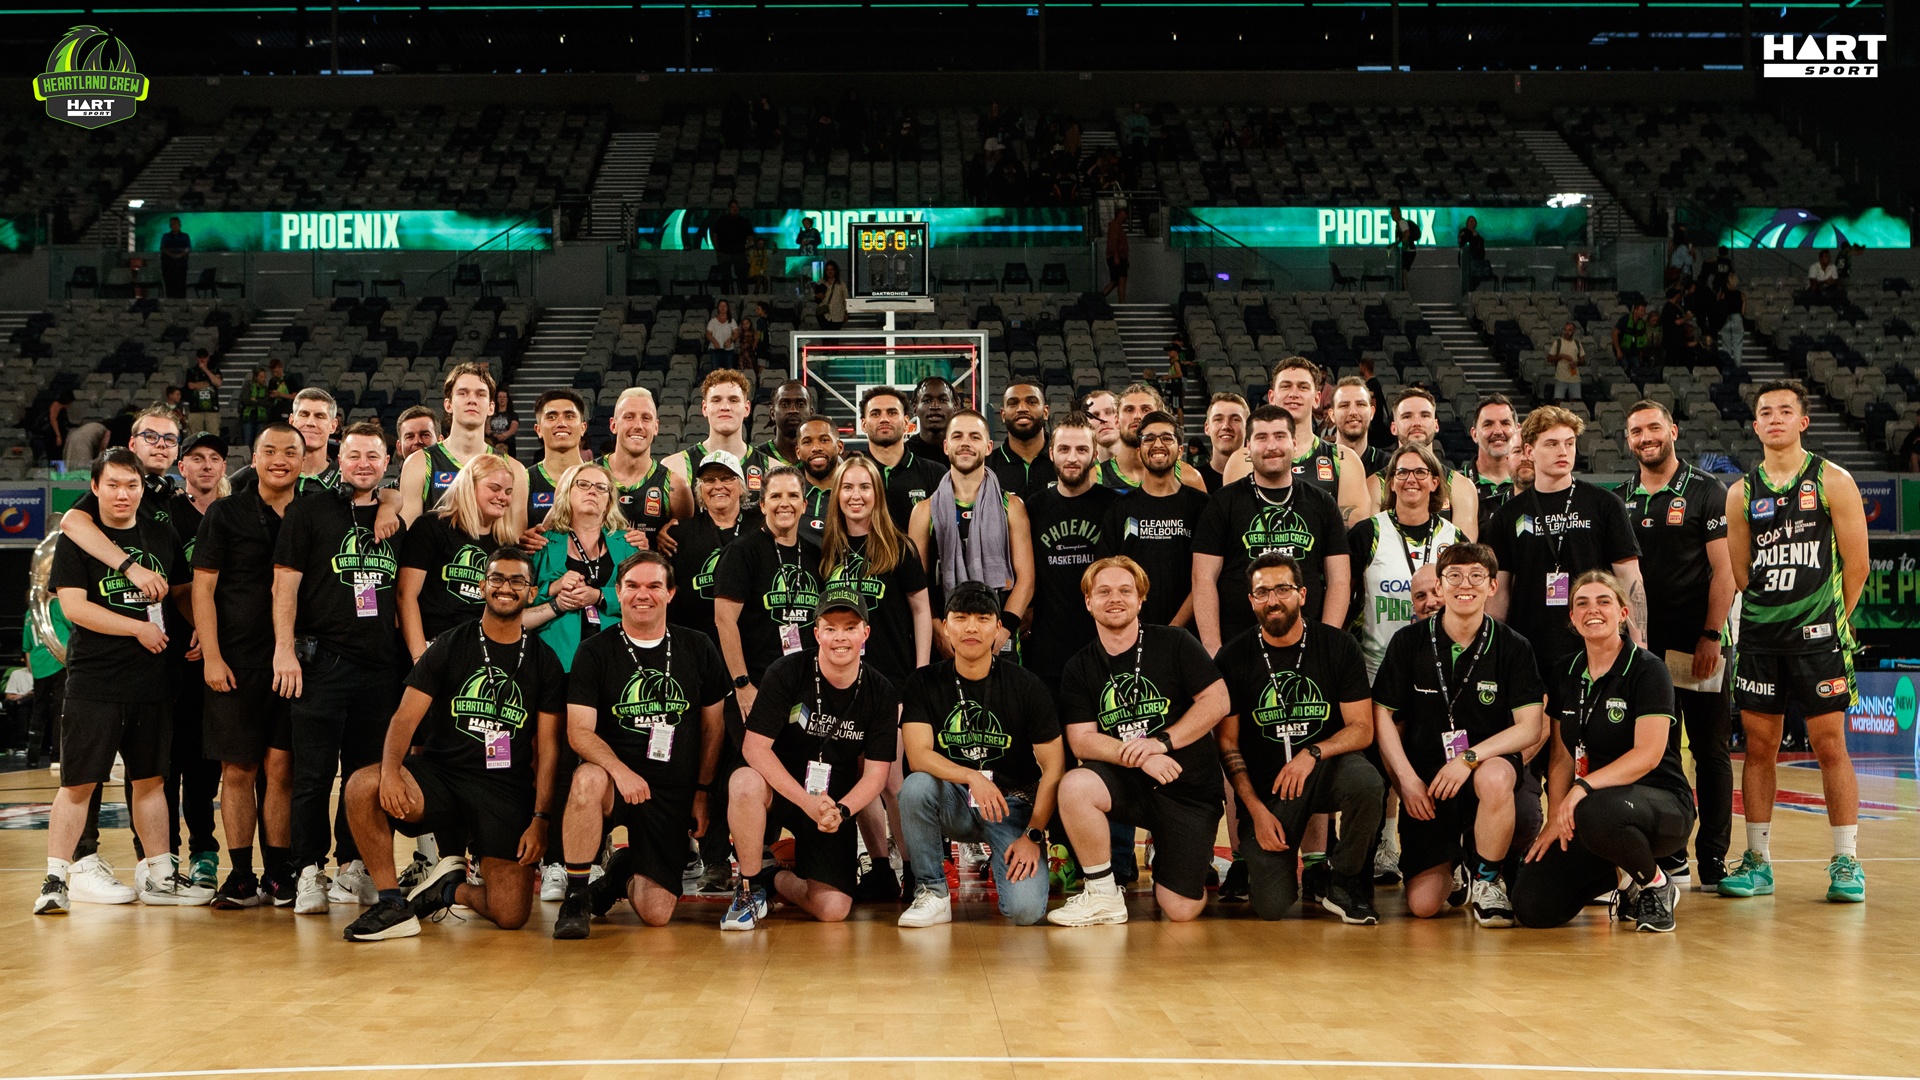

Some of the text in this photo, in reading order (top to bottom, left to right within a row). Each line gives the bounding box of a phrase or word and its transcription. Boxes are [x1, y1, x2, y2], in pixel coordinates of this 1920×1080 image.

[281, 213, 400, 249] PHOENIX
[713, 451, 721, 462] P
[1139, 519, 1184, 528] CLEANING
[1534, 512, 1579, 524] CEANNG
[1534, 519, 1591, 532] MLBURNE
[1139, 527, 1192, 539] MELBOURNE
[1248, 532, 1310, 546] HEARLAND CREW
[338, 556, 397, 573] HEARAND CREW
[353, 571, 384, 580] HART
[1764, 567, 1797, 592] 30
[861, 581, 880, 594] CREW
[1735, 675, 1776, 696] TRADIE
[618, 701, 686, 715] HEARTLAN CREW
[1896, 696, 1914, 710] NEW
[456, 700, 523, 723] HEARTLAN CREW
[634, 713, 668, 723] HART
[1101, 701, 1165, 726] HEARTLD CREW
[1257, 705, 1326, 722] HEARTND CREW
[469, 717, 503, 731] HART
[810, 712, 855, 730] CEANNG
[1117, 719, 1150, 733] HART
[1275, 722, 1310, 733] HART
[1851, 713, 1895, 734] warehouse
[984, 734, 1005, 746] CREW
